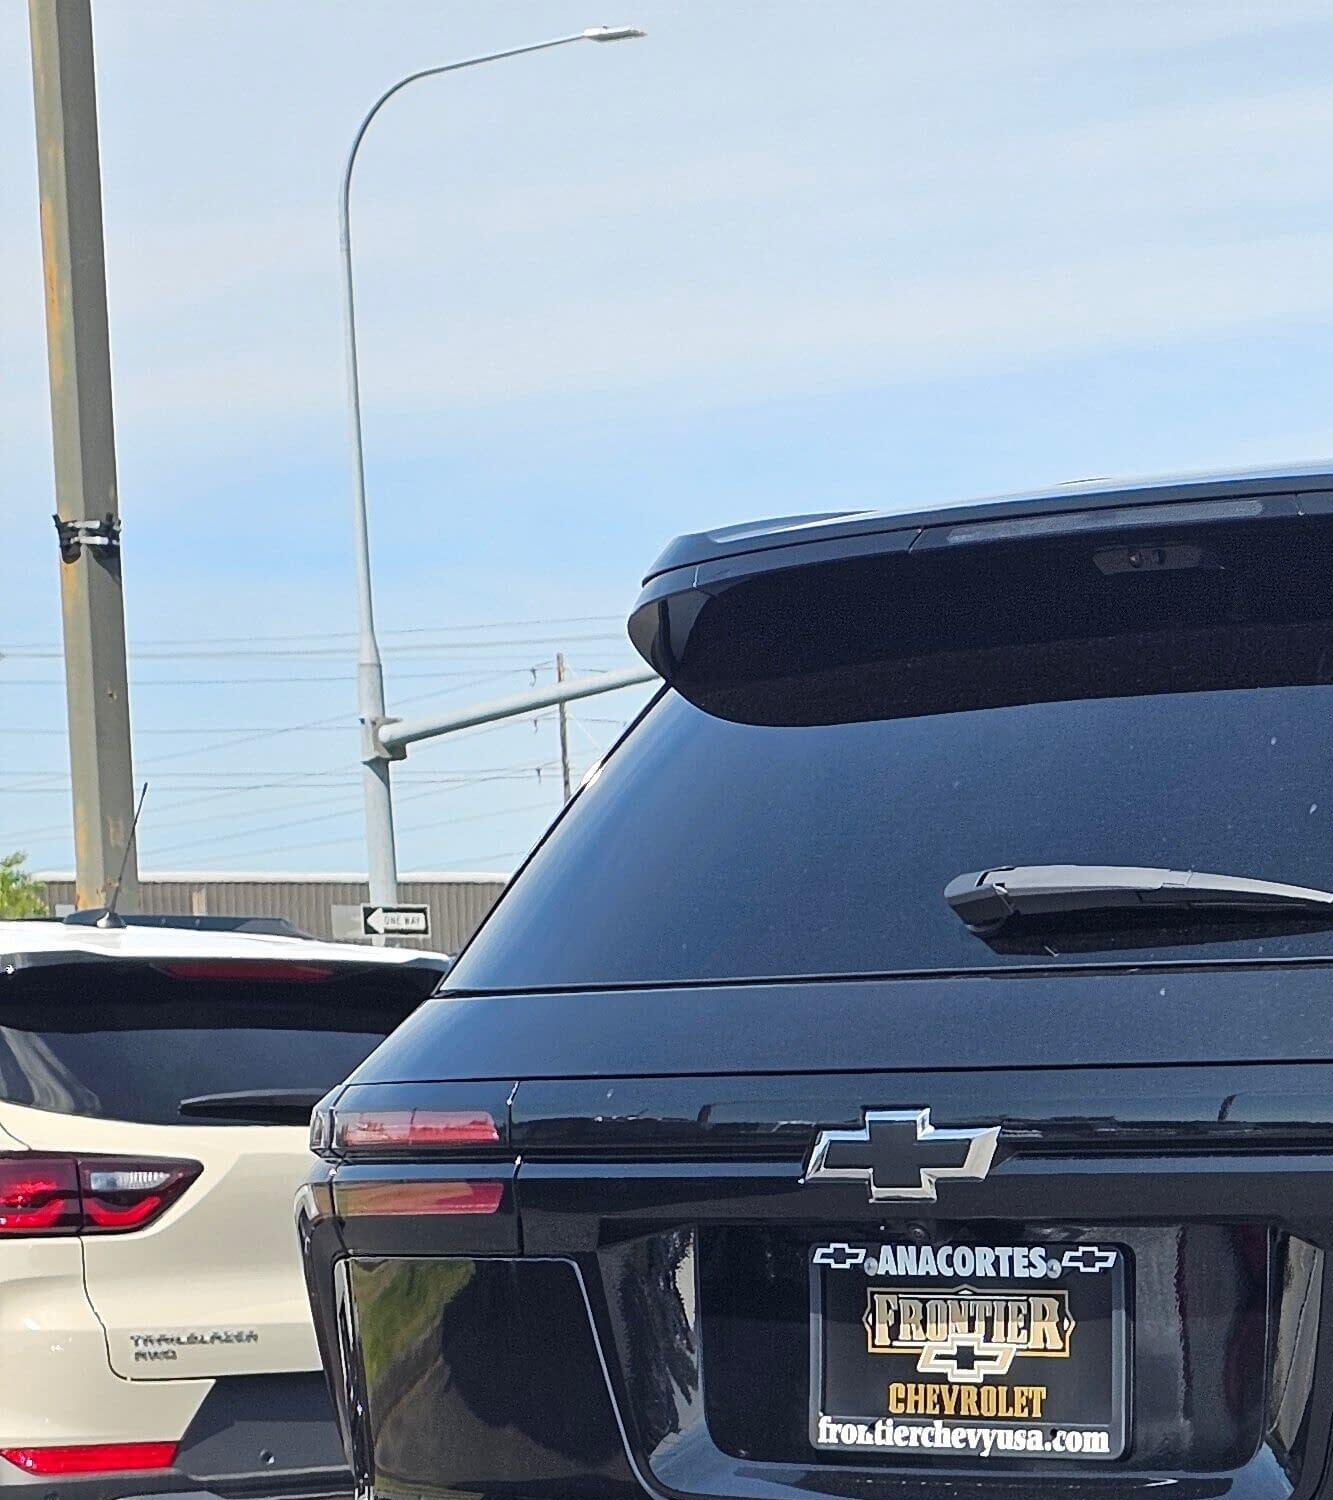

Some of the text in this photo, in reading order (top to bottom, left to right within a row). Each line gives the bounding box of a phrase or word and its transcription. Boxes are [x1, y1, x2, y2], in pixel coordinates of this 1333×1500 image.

[384, 915, 421, 926] ONE WAY
[877, 1245, 1047, 1278] ANACORTES
[873, 1293, 1063, 1350] FRONTIER
[888, 1382, 1047, 1418] CHEVROLET
[817, 1415, 1110, 1457] frontierchevyusa.com
